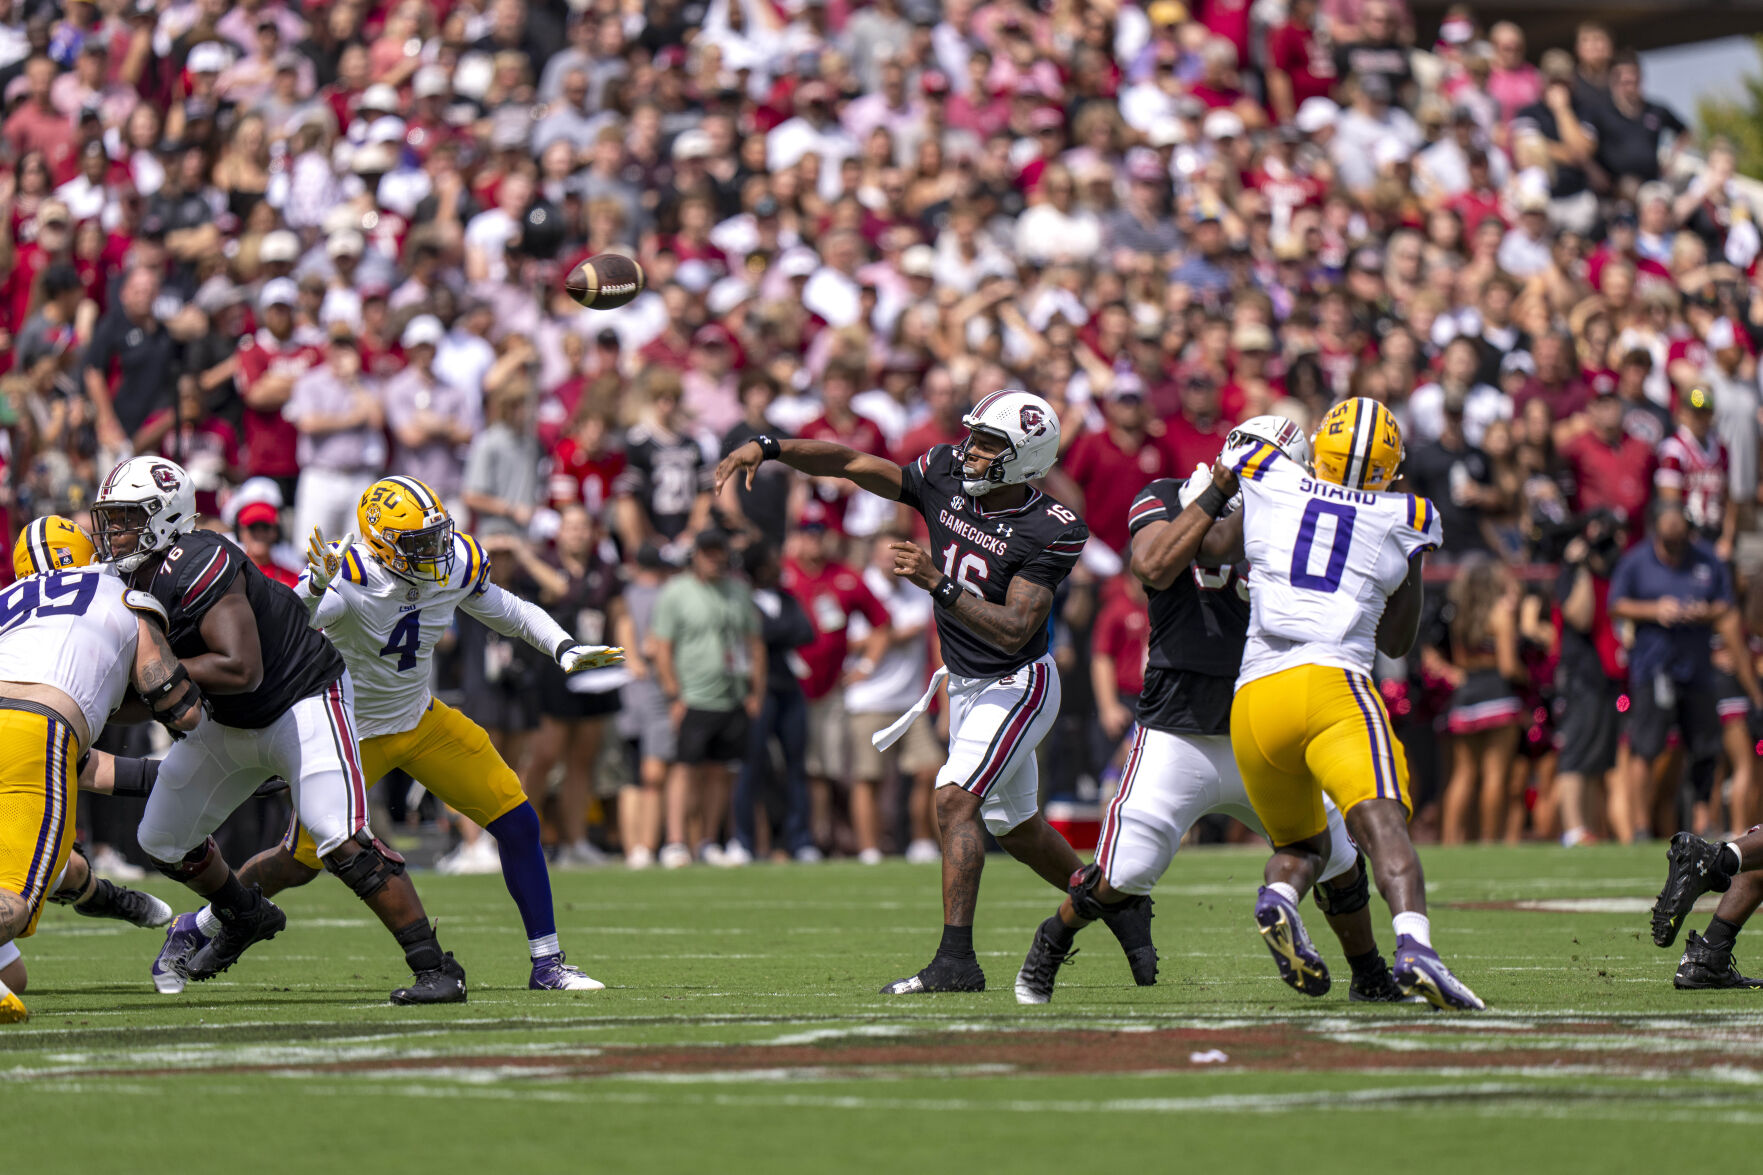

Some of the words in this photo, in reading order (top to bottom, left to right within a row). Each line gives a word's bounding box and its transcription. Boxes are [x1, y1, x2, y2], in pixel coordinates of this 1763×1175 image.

[360, 487, 400, 510] LSU
[950, 495, 965, 511] SEC
[1299, 477, 1377, 506] SHAND
[1046, 503, 1077, 525] 16
[939, 509, 1008, 556] GAMECOCKS
[1290, 498, 1356, 593] 0
[160, 545, 184, 576] 76
[943, 541, 990, 600] 16
[0, 572, 99, 636] 99
[399, 604, 417, 613] LSU
[379, 608, 422, 673] 4
